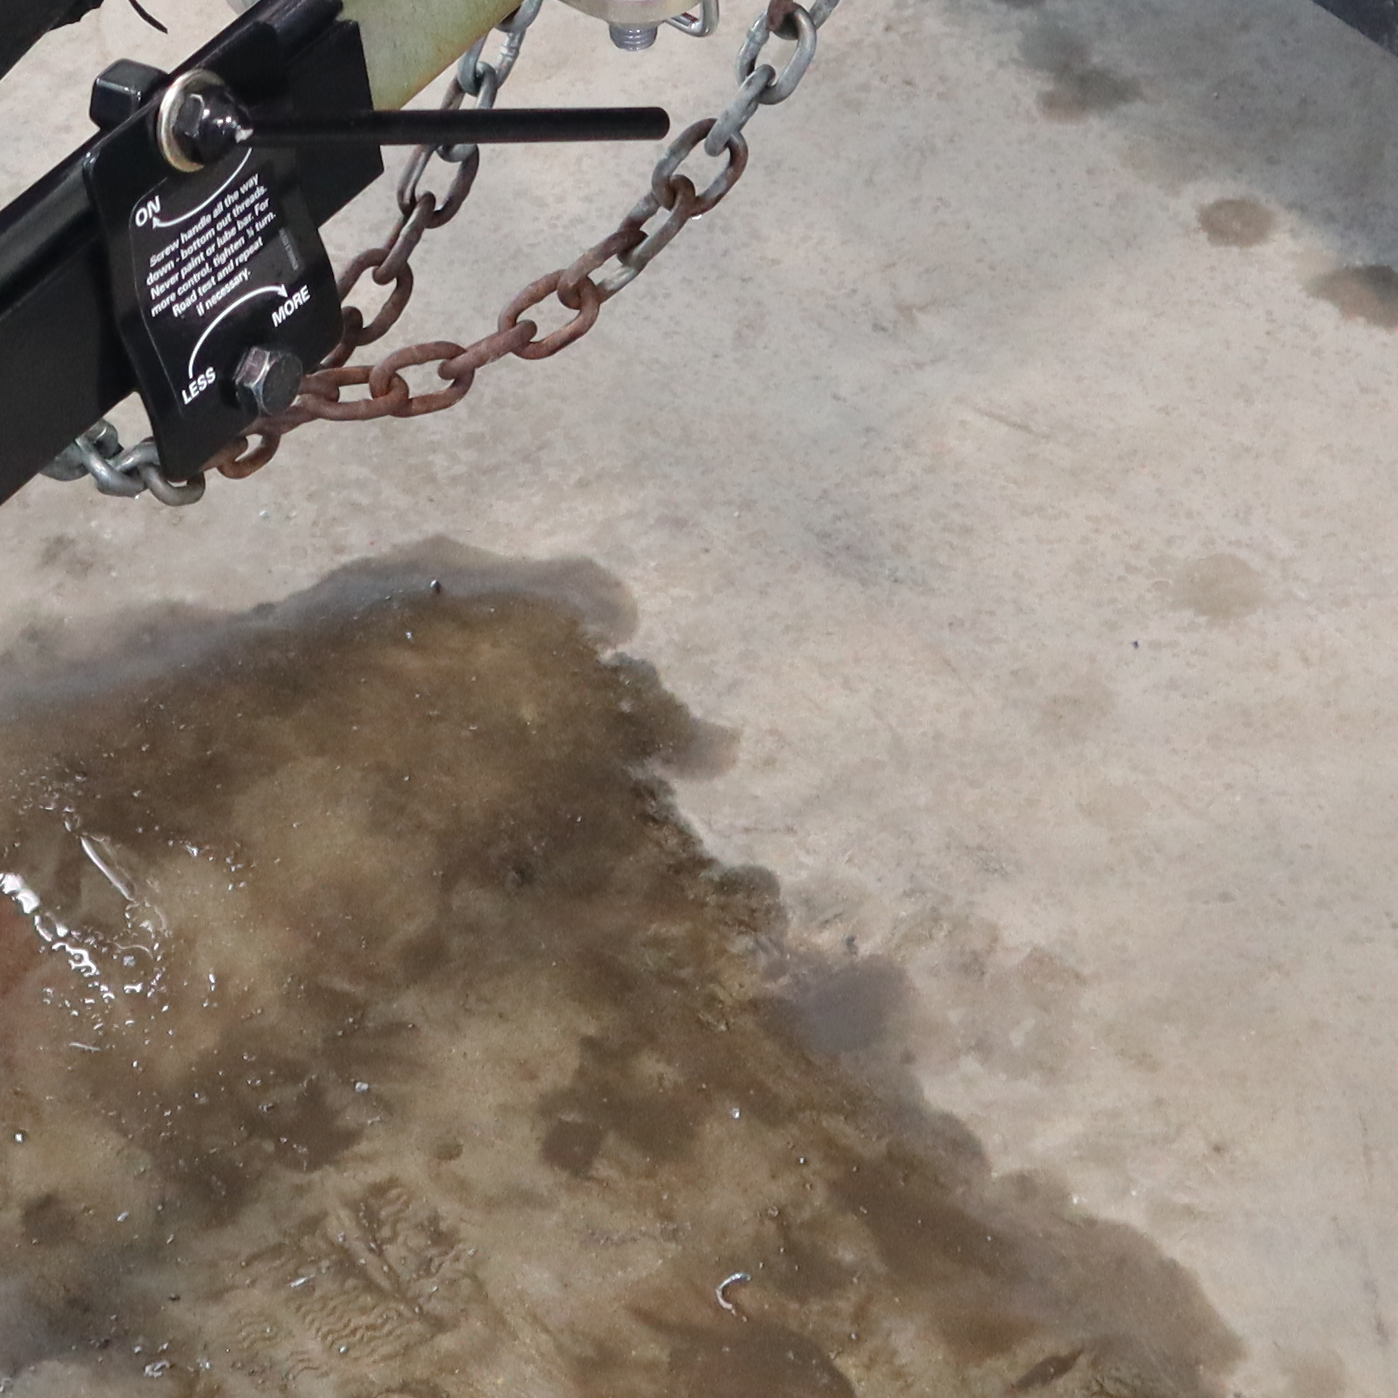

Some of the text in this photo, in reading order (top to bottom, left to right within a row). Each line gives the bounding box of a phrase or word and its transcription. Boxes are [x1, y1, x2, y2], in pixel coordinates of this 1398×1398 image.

[135, 195, 161, 227] ON
[146, 260, 175, 285] down
[180, 228, 215, 260] bottom
[216, 213, 232, 231] out
[232, 185, 268, 218] threads.
[150, 173, 259, 267] Screw handle all the way
[150, 198, 270, 300] Never paint or lube bar. For
[150, 292, 176, 317] more
[177, 262, 213, 296] control,
[212, 236, 245, 268] tighten
[254, 211, 277, 232] turn.
[172, 289, 197, 317] Road
[197, 275, 217, 297] test
[216, 259, 235, 282] and
[234, 236, 264, 266] repeat
[195, 267, 251, 317] if necessary.
[271, 284, 312, 328] MORE
[181, 367, 217, 405] LESS
